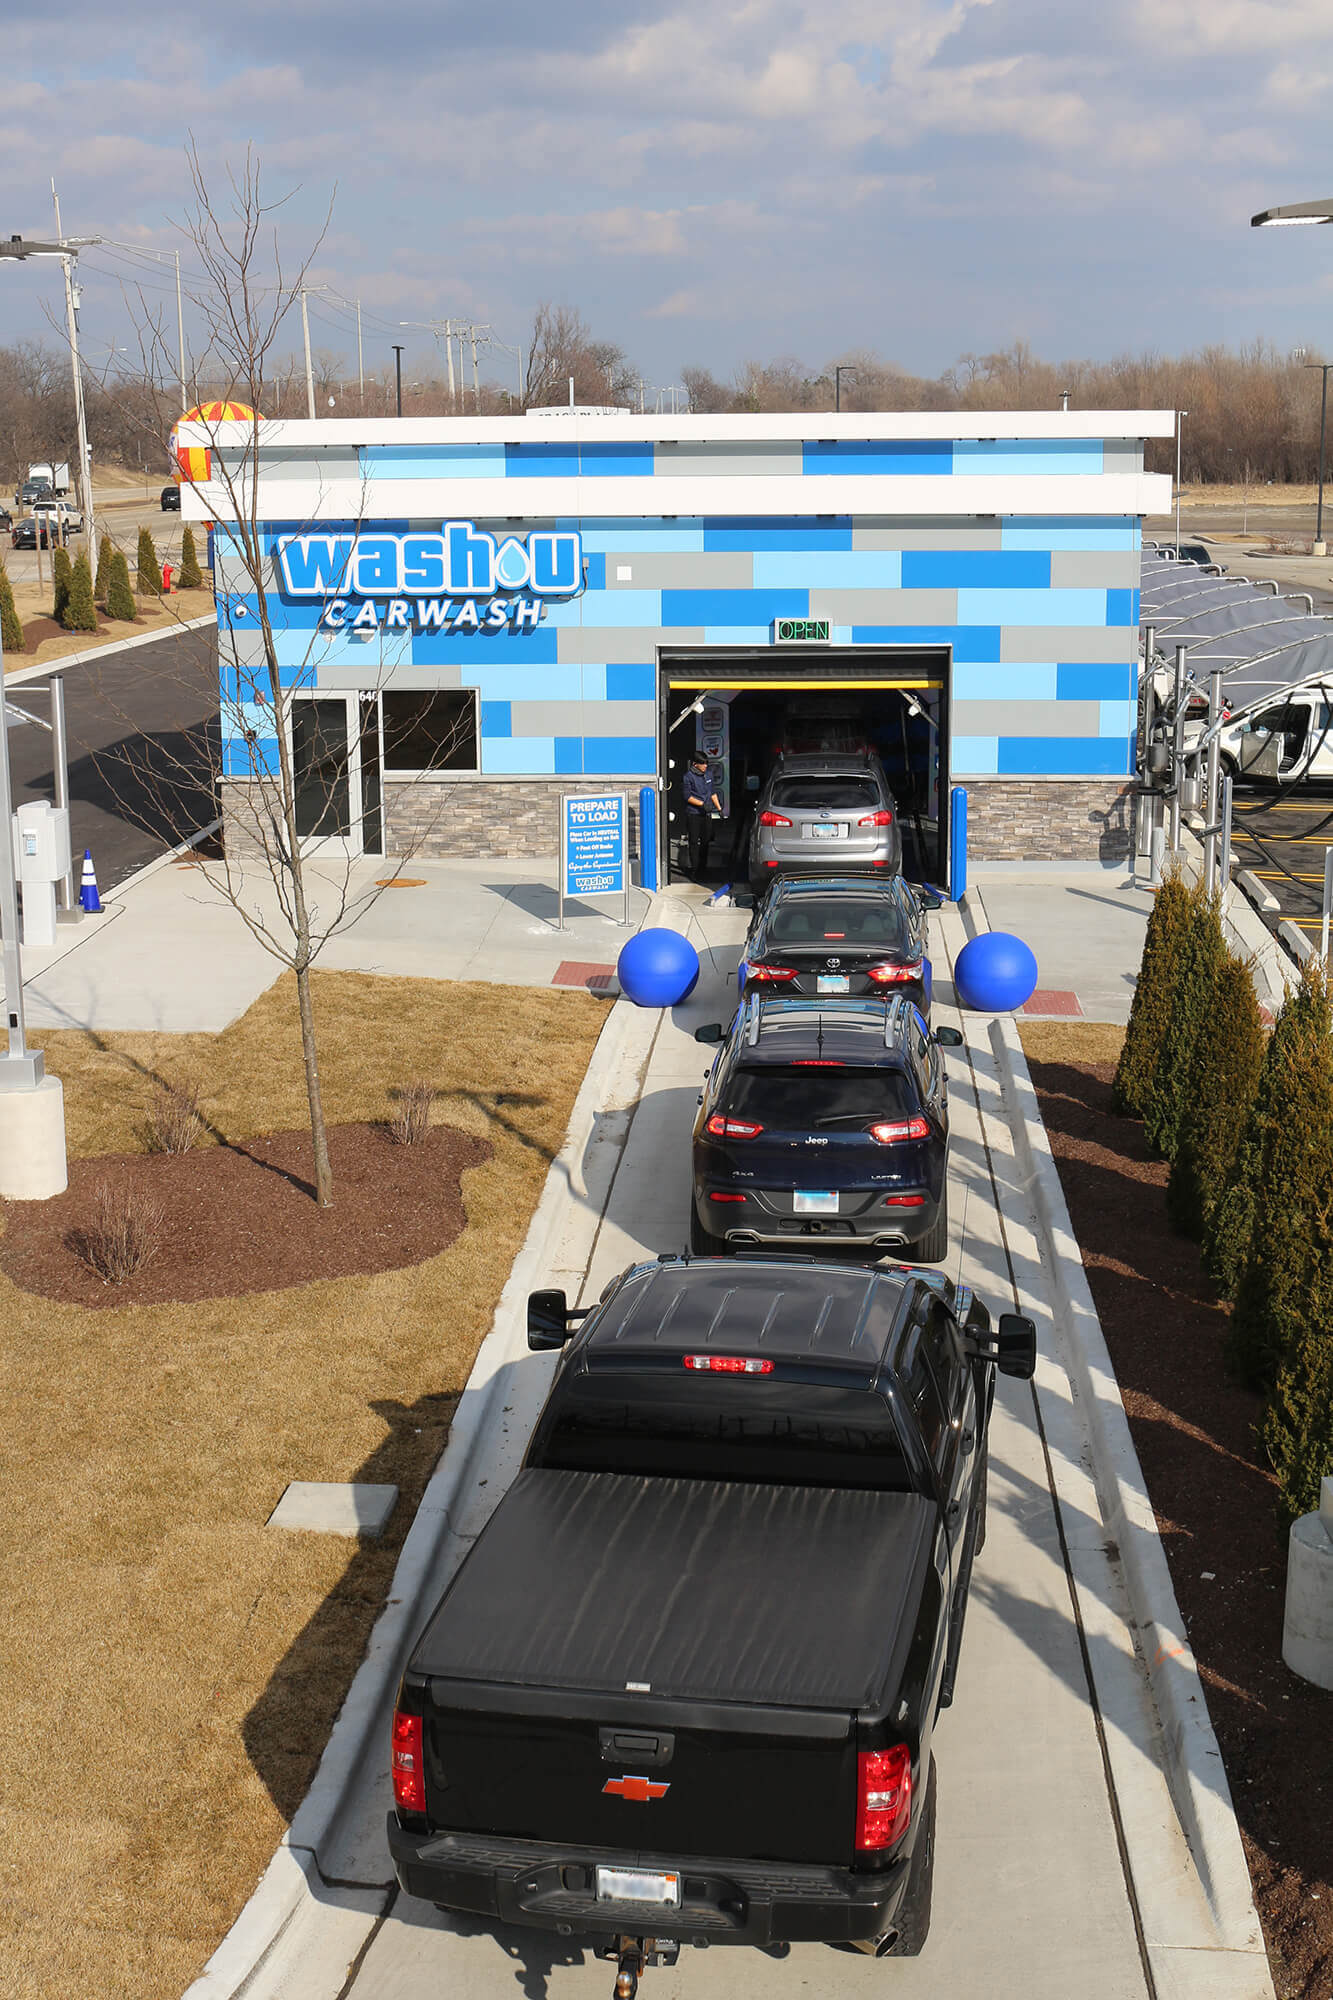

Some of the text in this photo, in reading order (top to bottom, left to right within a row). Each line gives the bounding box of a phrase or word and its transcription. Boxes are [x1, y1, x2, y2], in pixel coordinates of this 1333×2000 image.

[324, 599, 543, 627] CARWASH
[779, 621, 828, 640] OPEN
[570, 800, 619, 812] PREPARE
[570, 811, 618, 824] TO LOAD
[805, 1136, 829, 1146] Jeep
